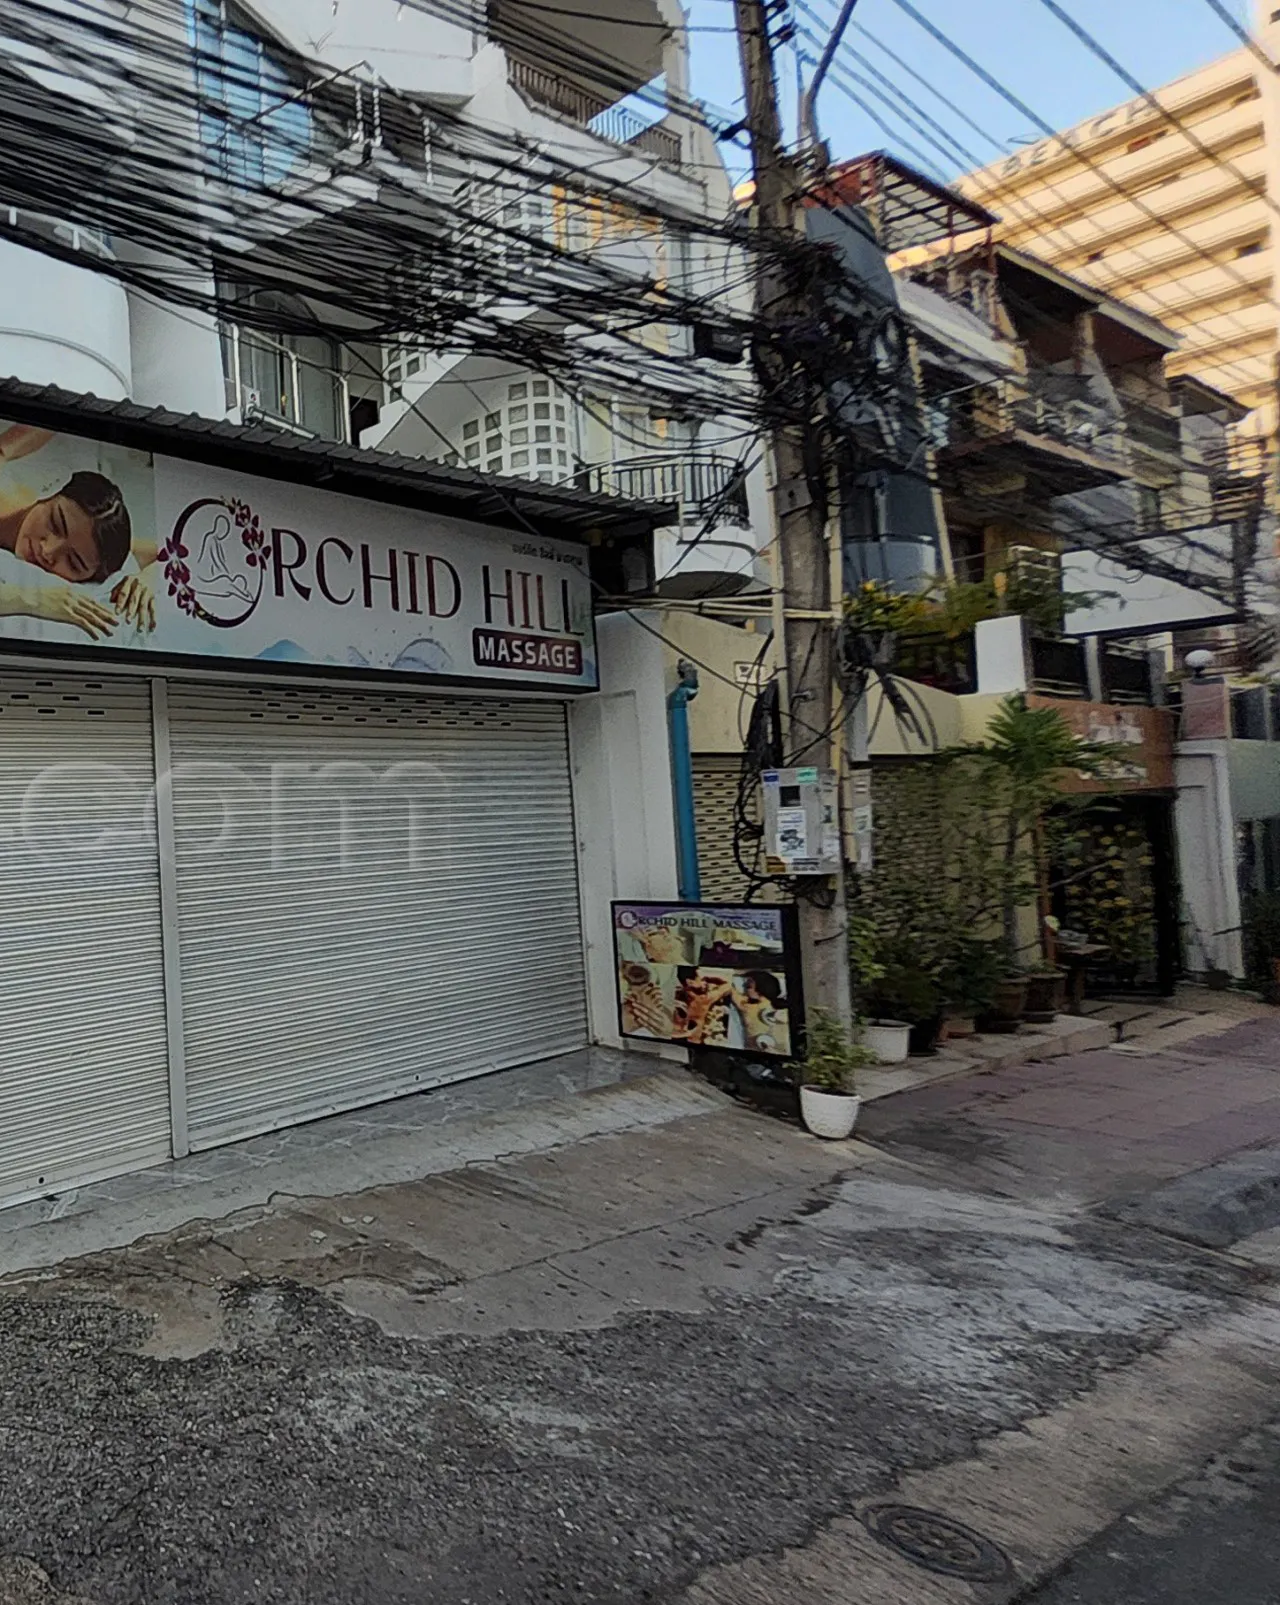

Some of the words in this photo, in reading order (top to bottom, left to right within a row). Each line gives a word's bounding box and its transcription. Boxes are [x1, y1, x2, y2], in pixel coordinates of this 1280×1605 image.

[482, 564, 585, 636] HILL
[478, 635, 577, 669] MASSAGE
[681, 917, 708, 928] HILL
[712, 918, 777, 931] MASSAGE
